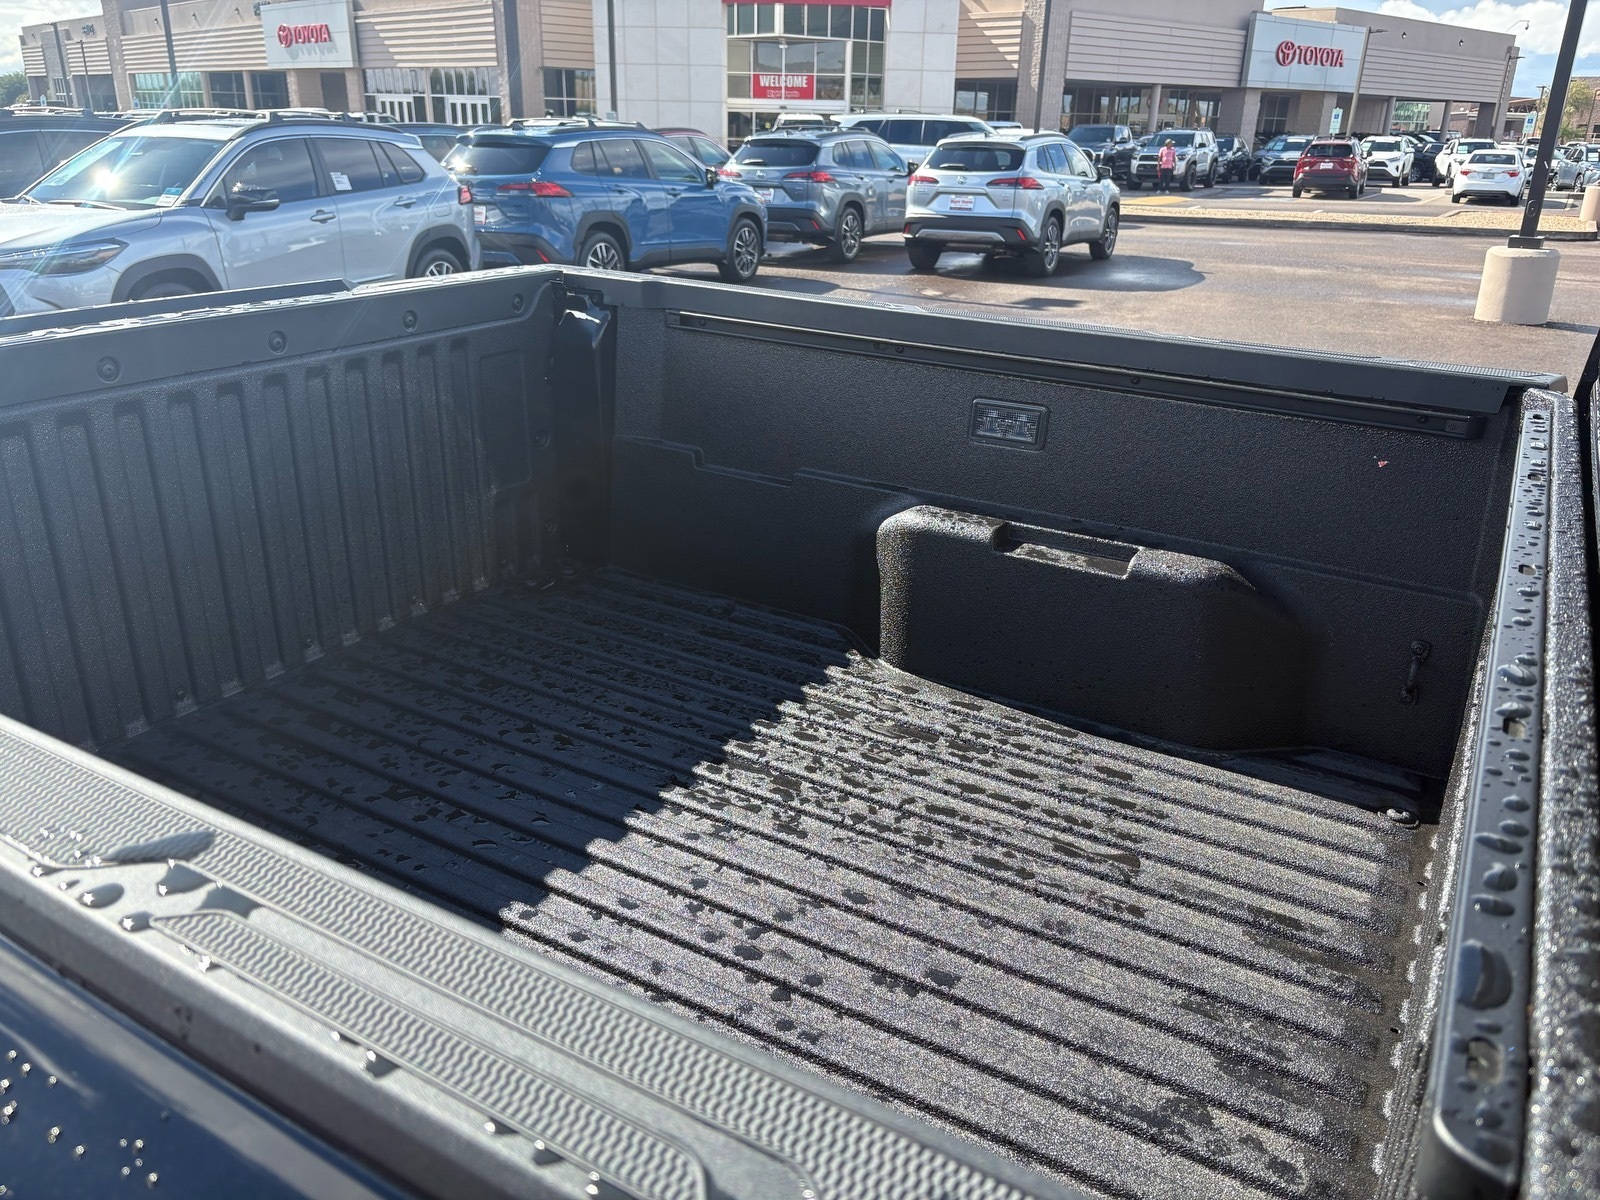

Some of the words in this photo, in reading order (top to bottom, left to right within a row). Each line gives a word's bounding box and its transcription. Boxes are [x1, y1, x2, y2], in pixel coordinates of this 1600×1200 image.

[293, 24, 332, 44] TOYOTA
[1297, 45, 1344, 67] TOYOTA
[759, 75, 808, 88] WELCOME
